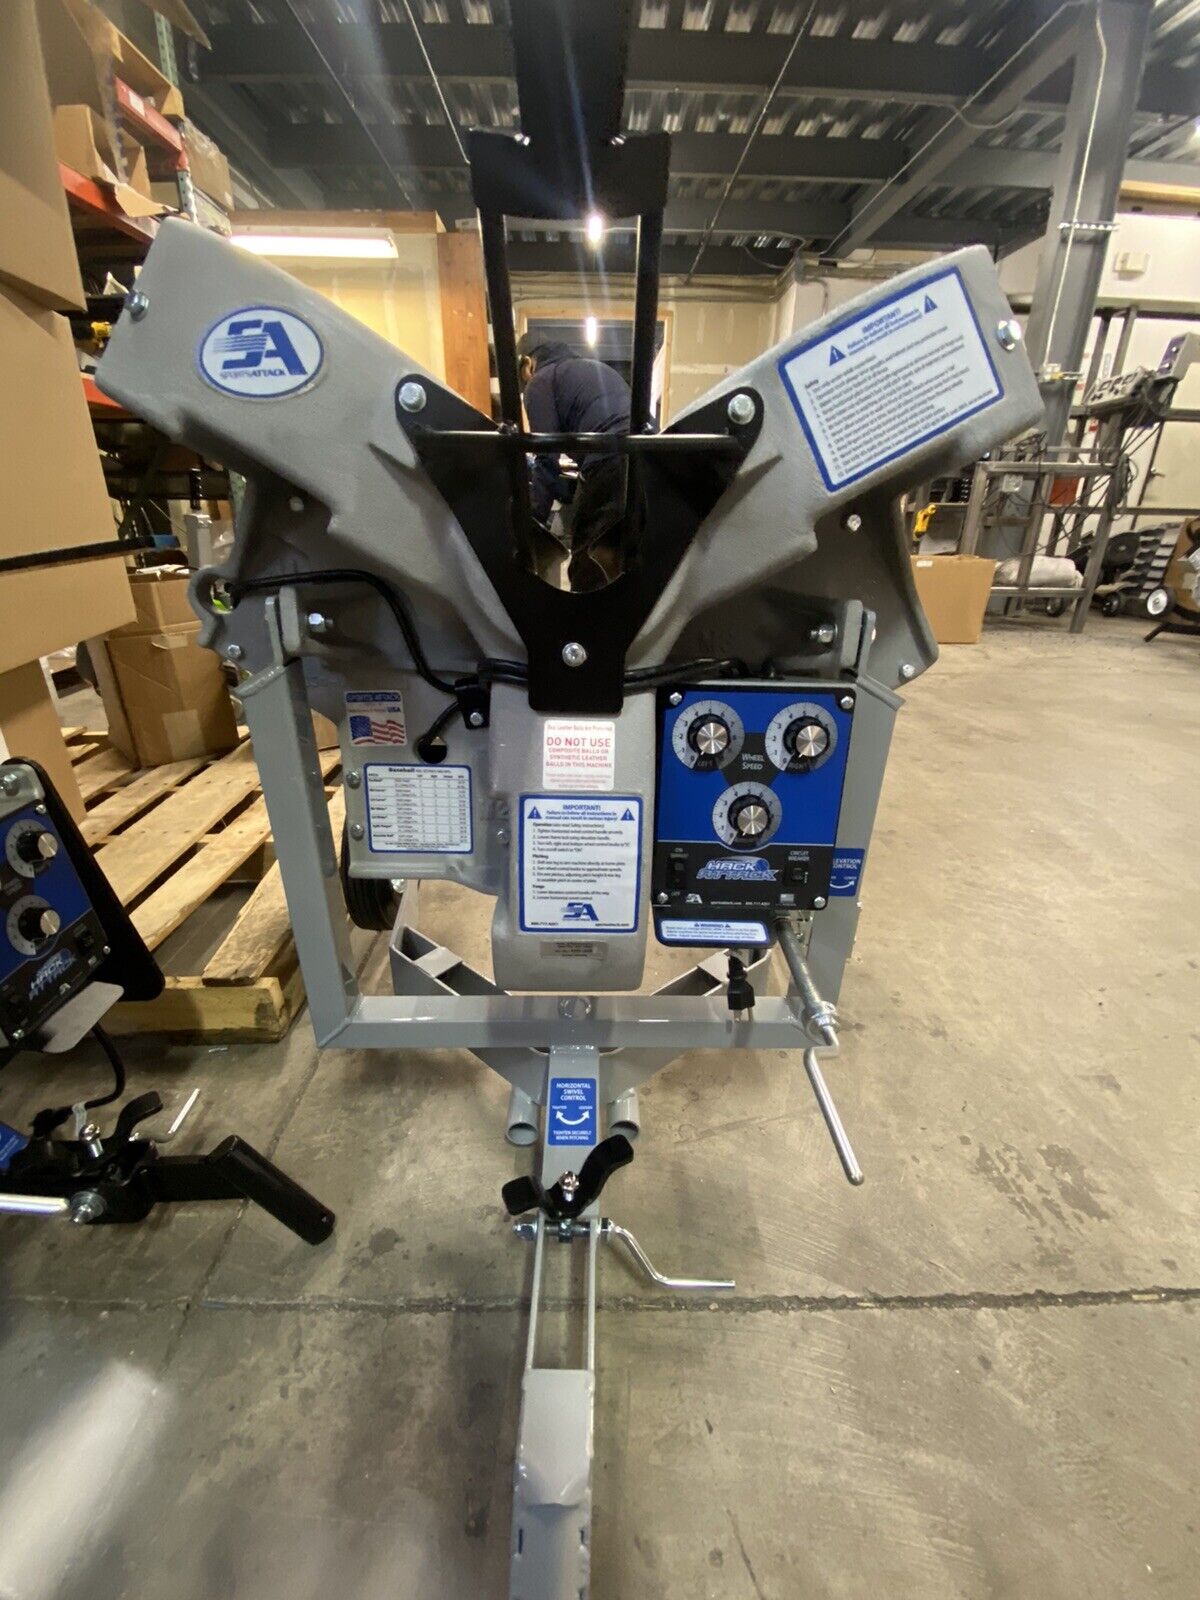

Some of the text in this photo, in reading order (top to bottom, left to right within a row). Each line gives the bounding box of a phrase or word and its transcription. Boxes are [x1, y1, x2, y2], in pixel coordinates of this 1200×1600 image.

[861, 307, 901, 333] IMPORTANT!
[546, 737, 611, 747] DO NOT USE
[742, 753, 764, 761] WHEEL
[742, 762, 763, 770] SPEED
[705, 860, 756, 871] HACK
[696, 868, 779, 881] ATTACK
